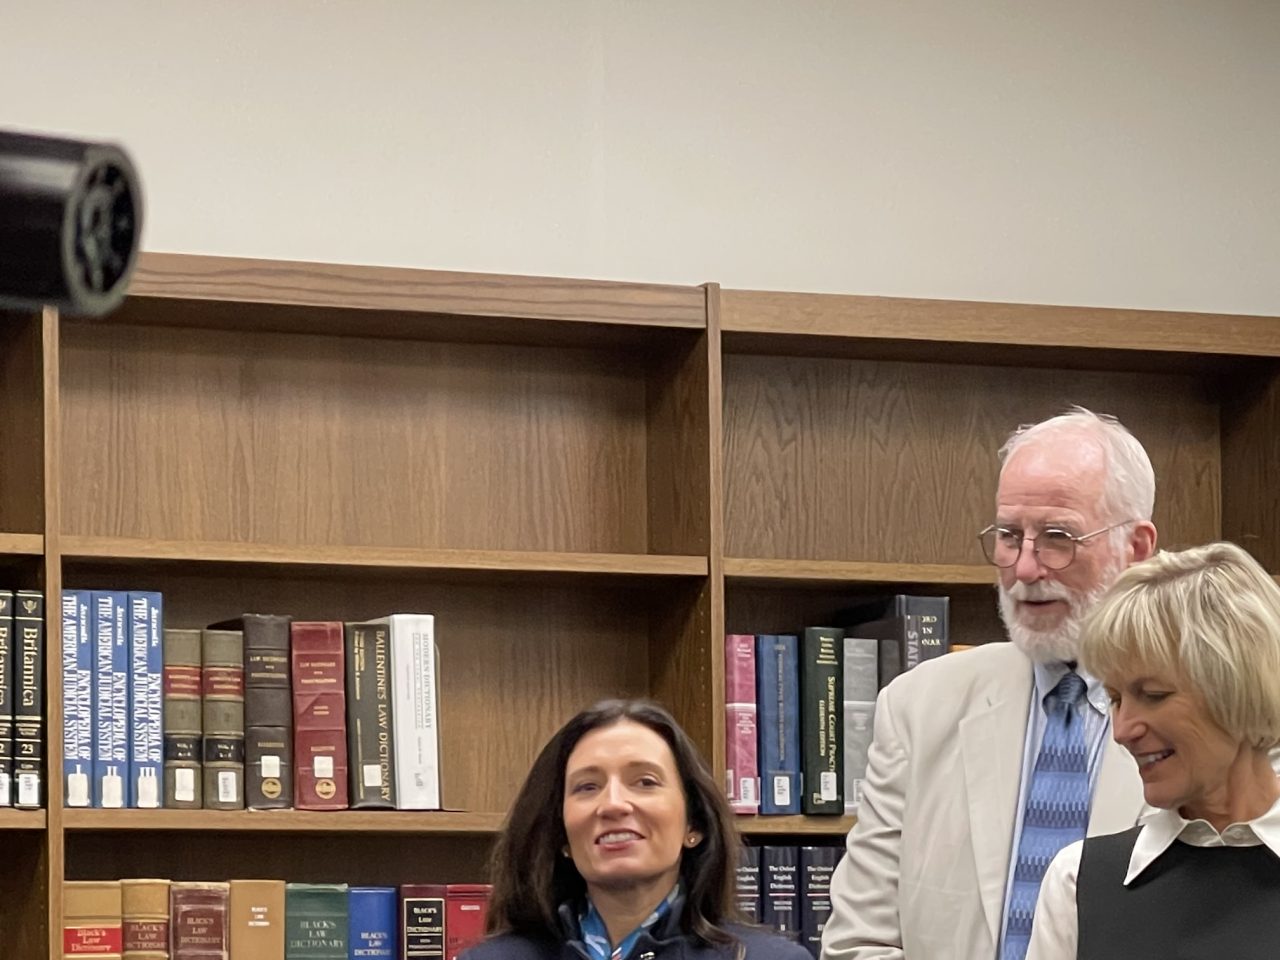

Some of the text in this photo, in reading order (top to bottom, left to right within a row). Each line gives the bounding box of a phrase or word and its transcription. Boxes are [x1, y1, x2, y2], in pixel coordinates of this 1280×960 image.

[23, 627, 38, 706] Britannica
[63, 595, 77, 760] THE AMERICAN JUDICIAL SYSTEM
[98, 597, 112, 761] THE AMERICAN JUDICIAL SYSTEM
[133, 598, 148, 762] THE AMERICAN JUDICIAL SYSTEM
[422, 633, 432, 729] MODERN DICTIONARY
[77, 670, 91, 761] ENCYCLOPEDIA OF
[112, 672, 126, 762] ENCYCLOPEDIA OF
[148, 673, 162, 763] ENCYCLOPEDIA OF
[378, 703, 388, 728] LAW
[827, 676, 837, 742] SUPREME COURT
[21, 743, 34, 754] 23
[379, 732, 391, 801] DICTIONARY
[76, 928, 107, 939] Black's
[192, 927, 208, 935] LAW
[300, 920, 337, 929] BLACK'S
[81, 936, 101, 945] Law
[138, 933, 157, 941] LAW
[180, 936, 221, 944] DICTIONARY
[309, 930, 327, 938] LAW
[360, 931, 388, 939] BLACK'S
[70, 944, 112, 952] Dictionary
[290, 940, 344, 948] DICTIONARY
